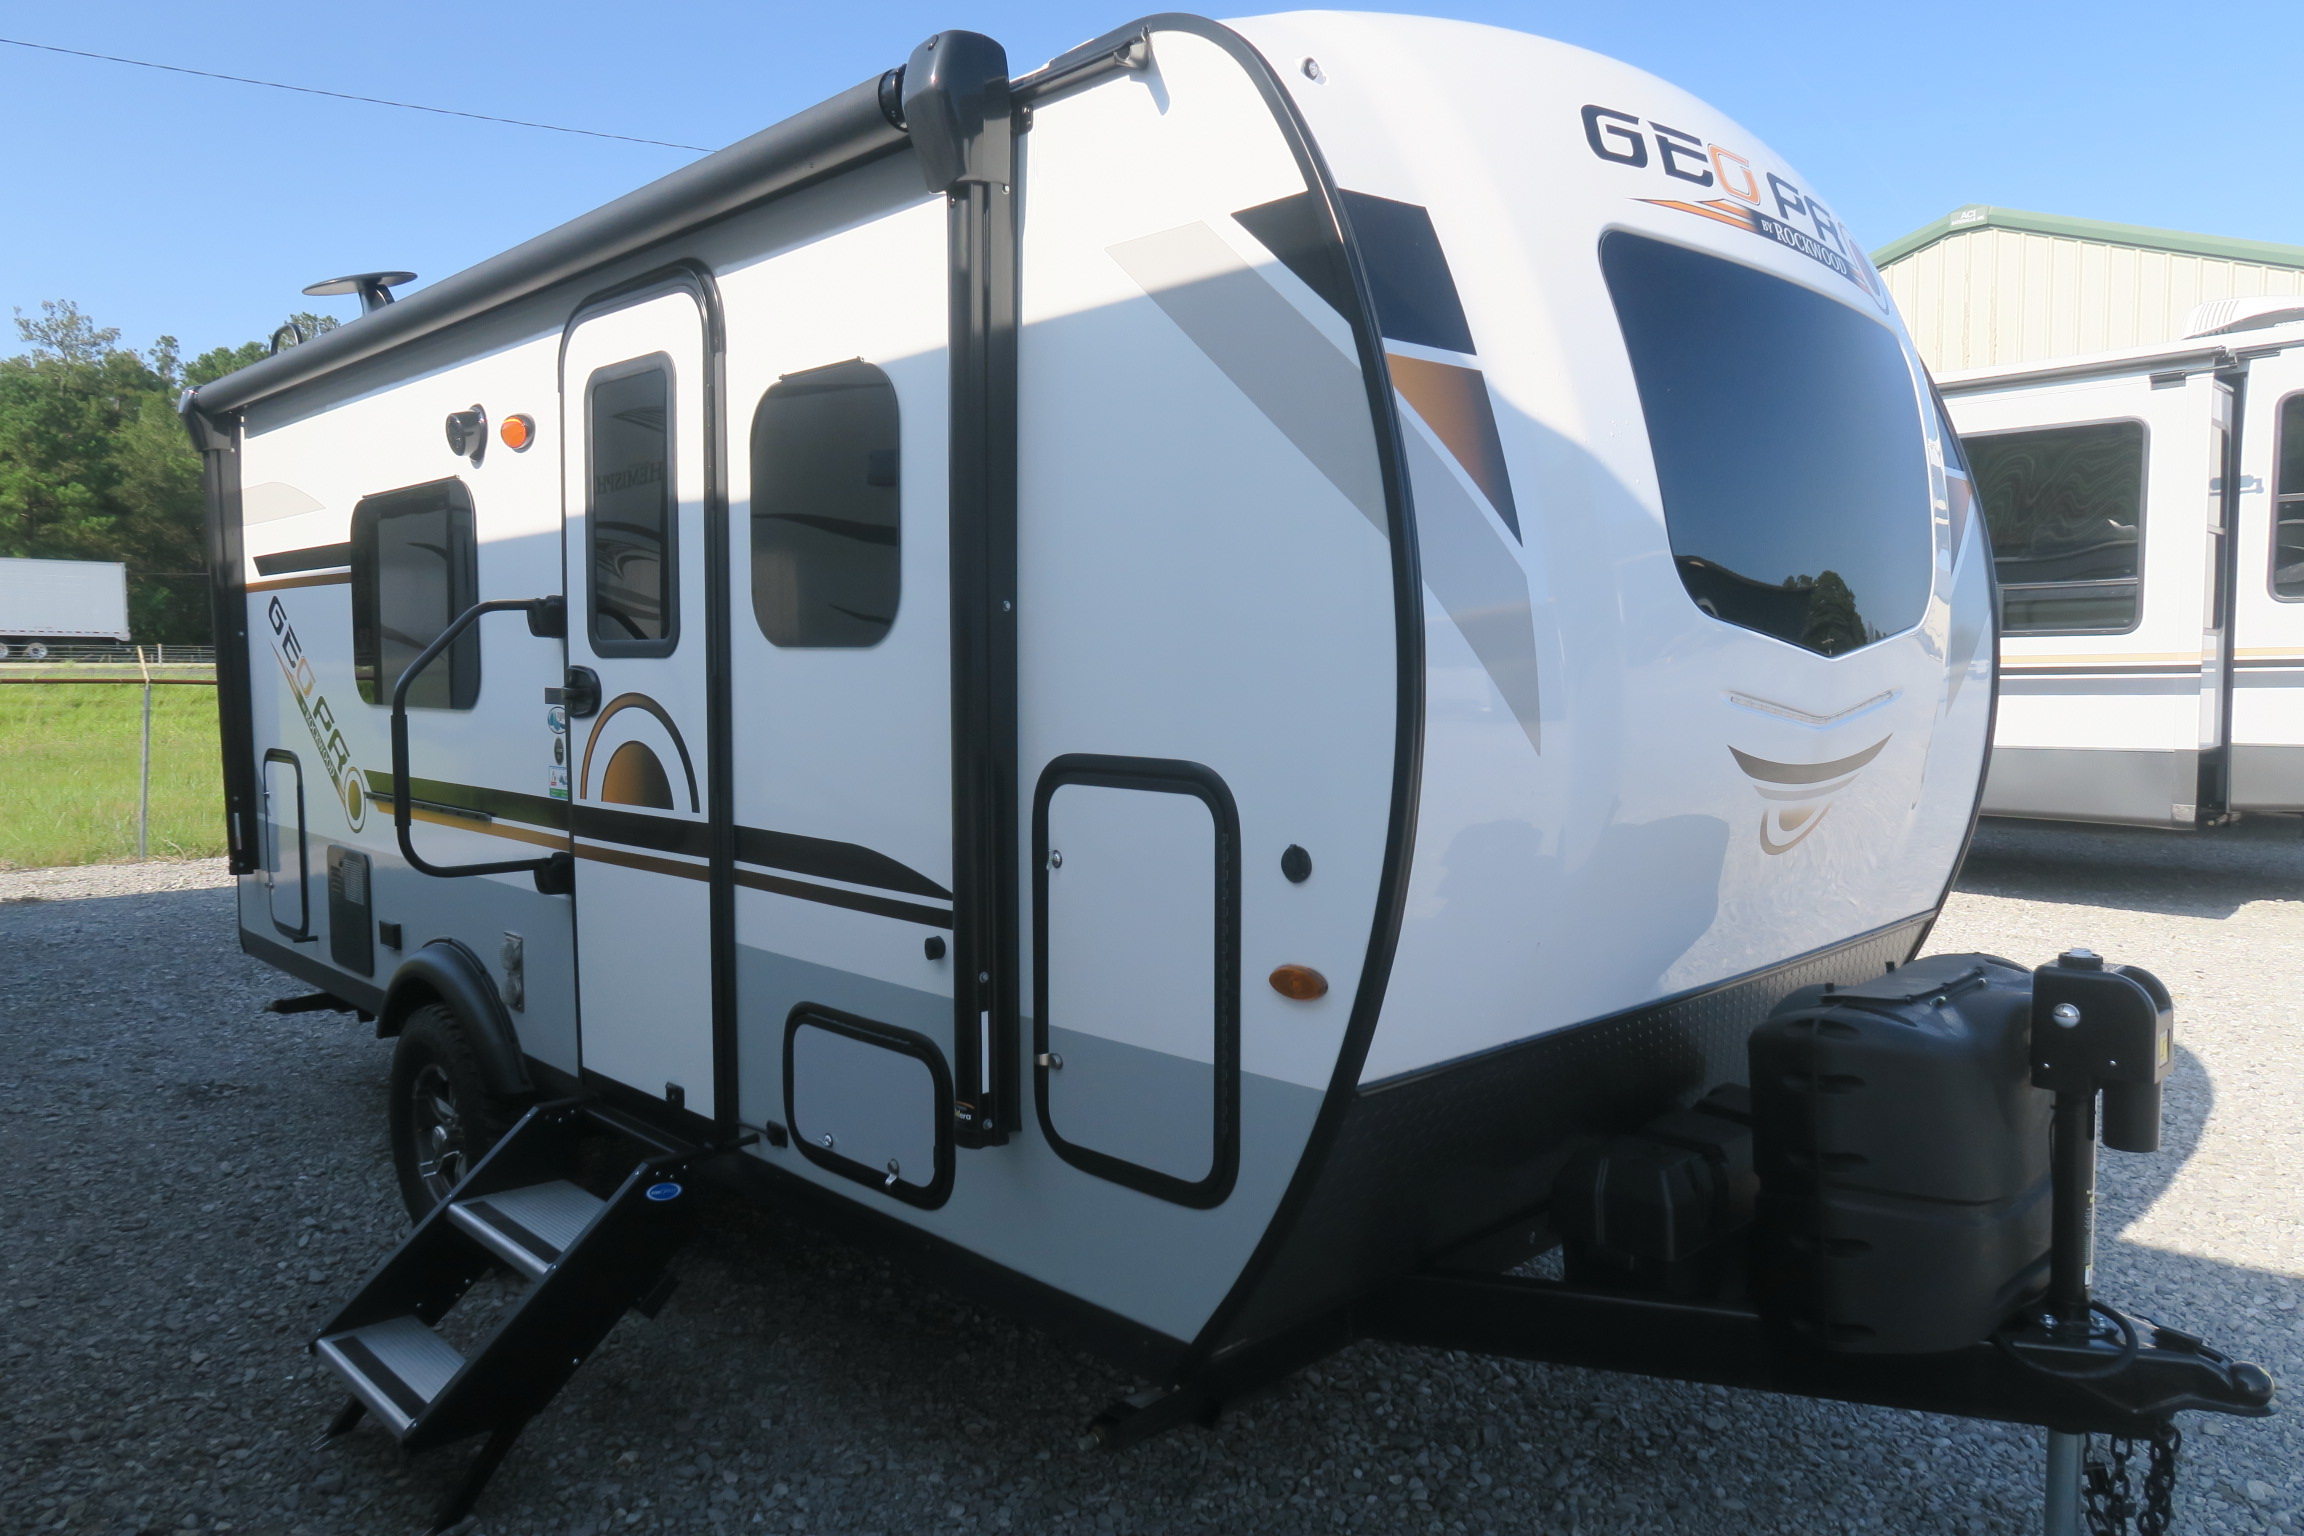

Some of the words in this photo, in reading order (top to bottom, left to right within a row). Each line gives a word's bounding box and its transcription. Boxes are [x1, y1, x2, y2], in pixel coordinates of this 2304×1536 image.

[1580, 104, 1760, 206] GEO
[1761, 218, 1773, 234] BY
[1773, 222, 1848, 276] ROCKWOOD
[268, 595, 317, 698] GEO
[313, 695, 367, 834] PRO
[305, 711, 336, 777] ROCKWOOD
